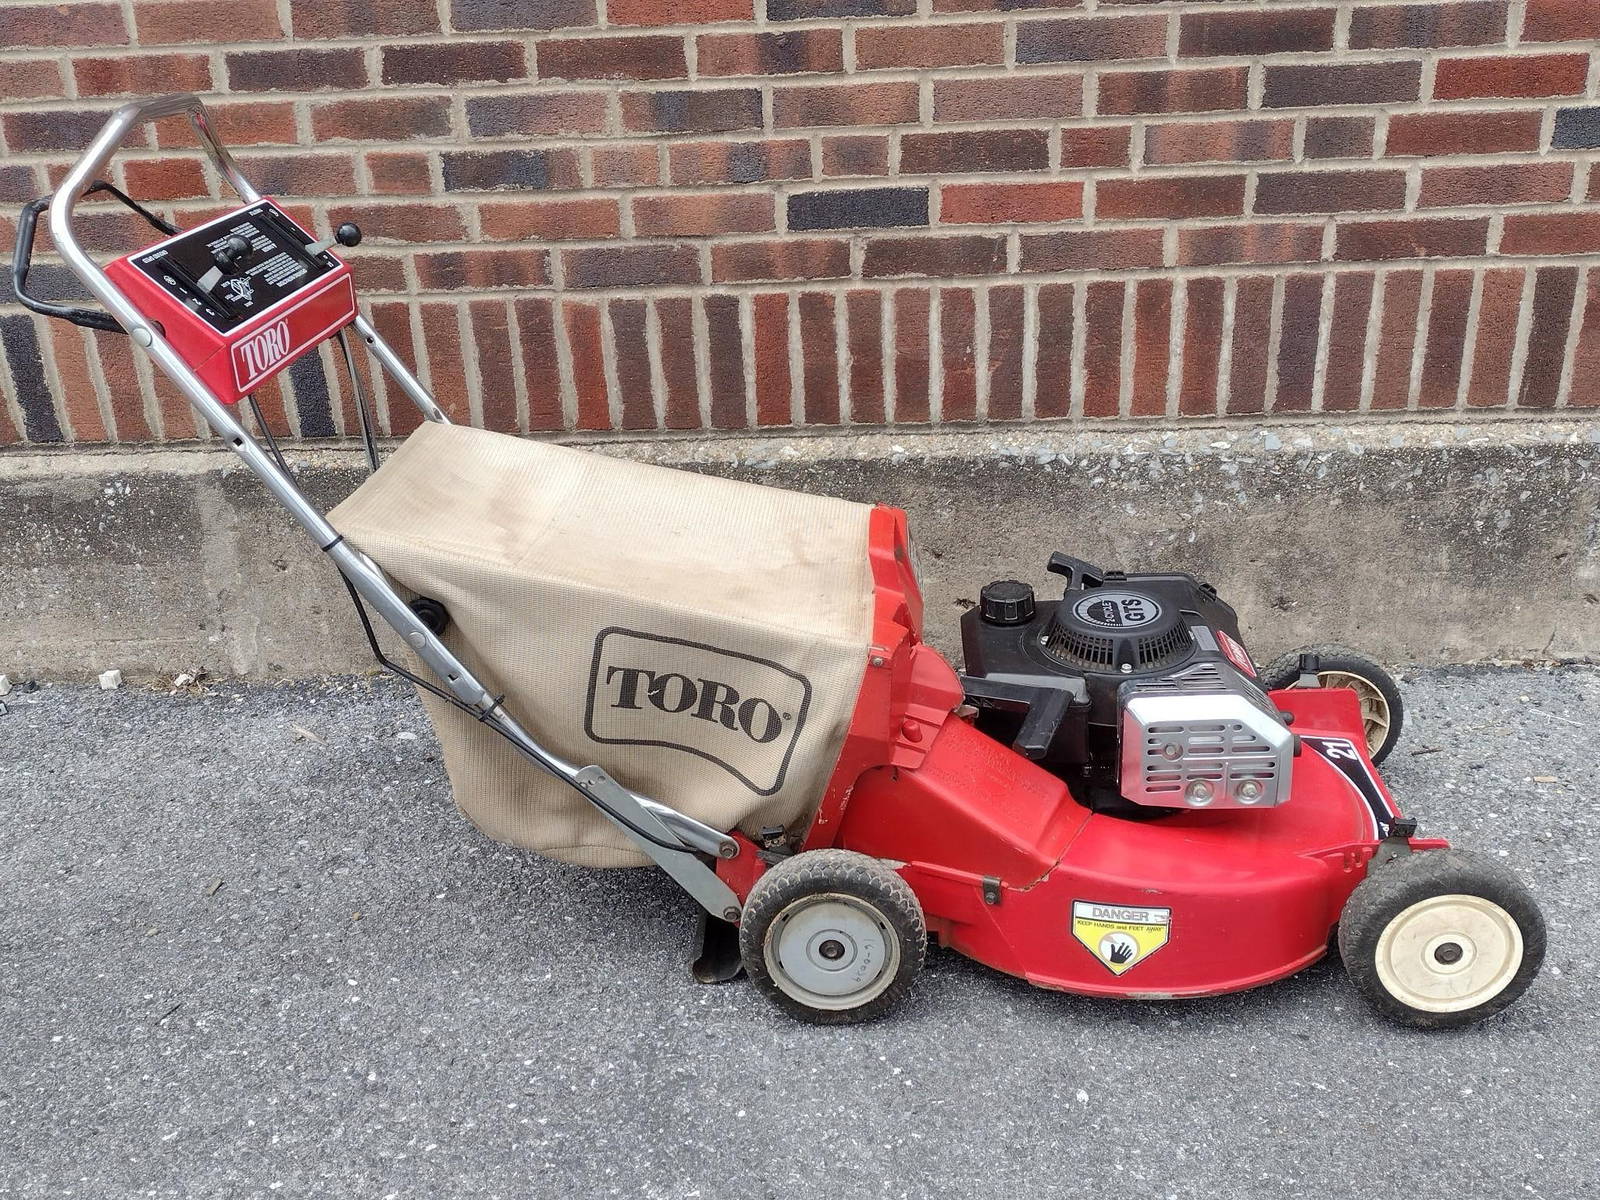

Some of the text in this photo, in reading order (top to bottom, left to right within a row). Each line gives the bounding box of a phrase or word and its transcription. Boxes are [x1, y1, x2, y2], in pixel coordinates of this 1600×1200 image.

[240, 319, 290, 380] TORO
[1120, 599, 1146, 621] GTS
[606, 666, 783, 744] TORO
[1321, 741, 1360, 761] 21
[1092, 907, 1150, 922] DANGER
[1077, 919, 1093, 927] KEEP
[1093, 921, 1115, 930] HANDS
[1128, 924, 1144, 932] FEET
